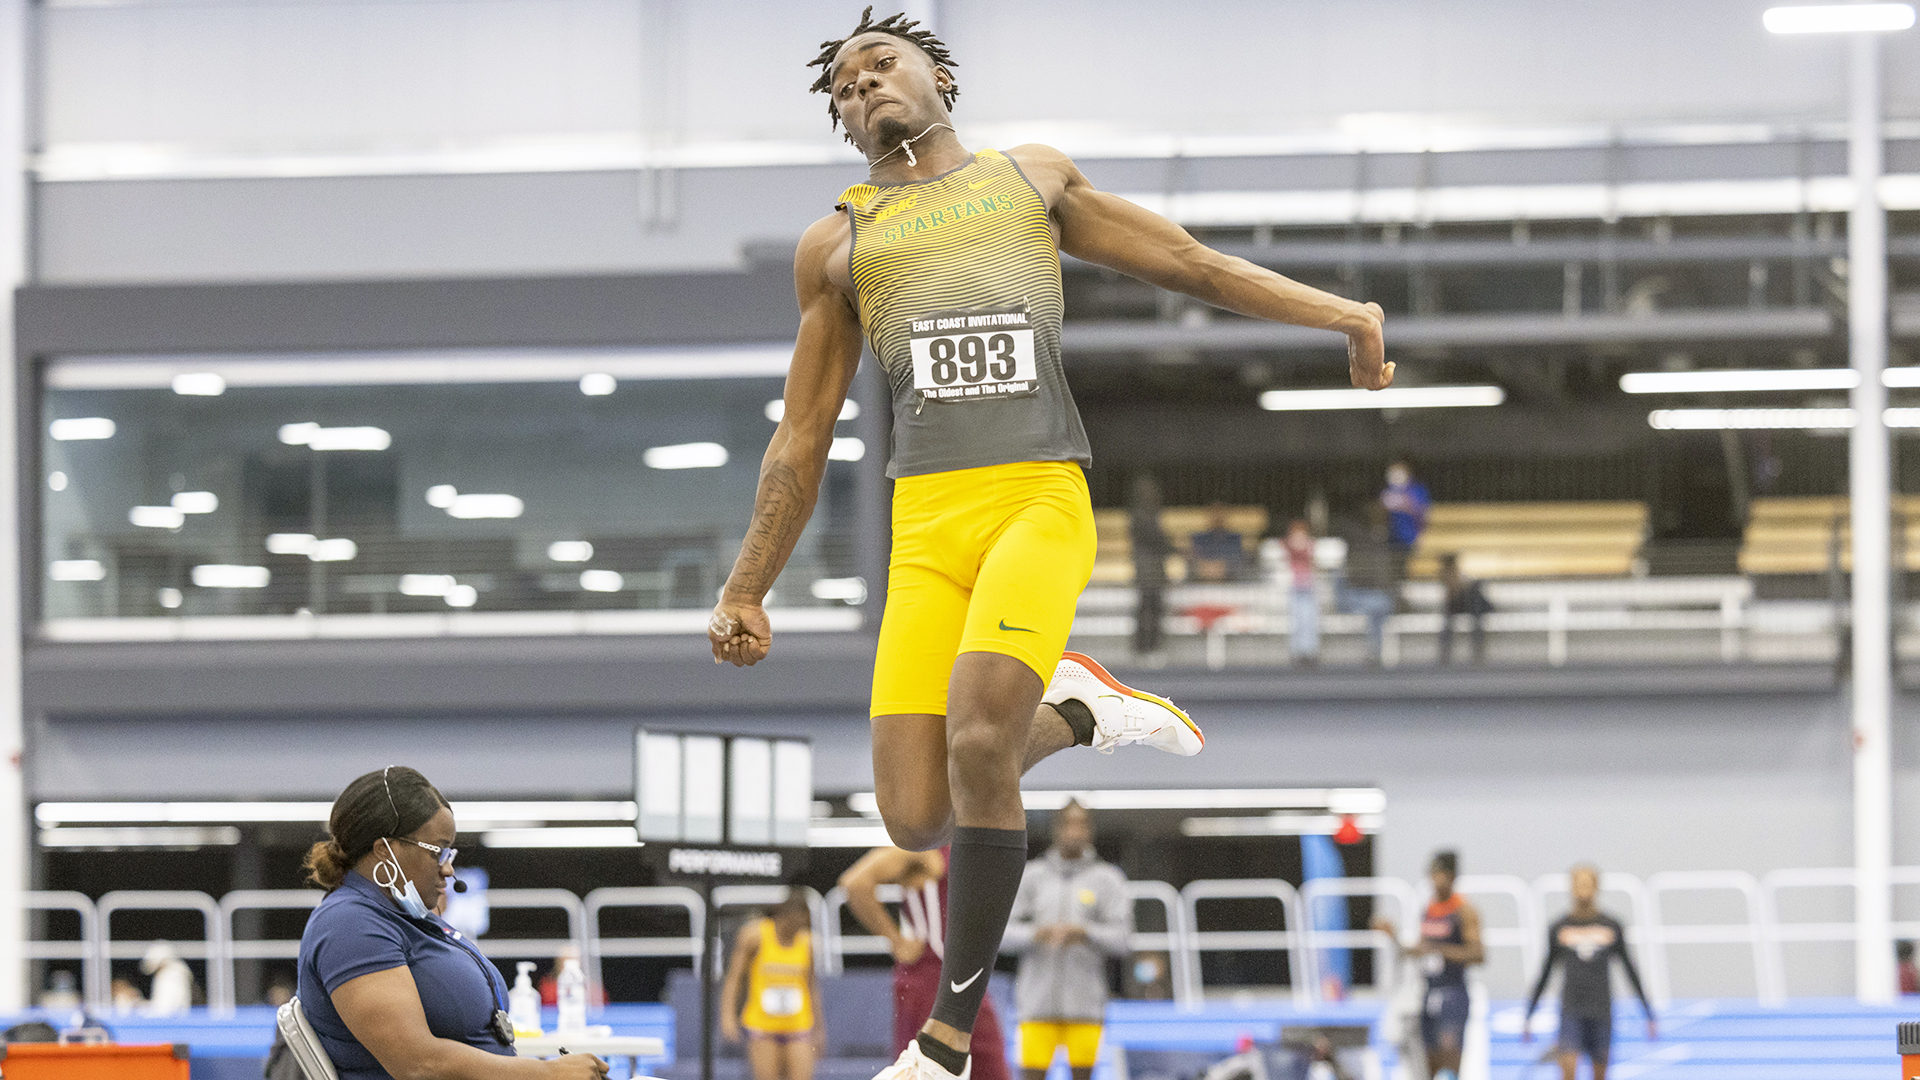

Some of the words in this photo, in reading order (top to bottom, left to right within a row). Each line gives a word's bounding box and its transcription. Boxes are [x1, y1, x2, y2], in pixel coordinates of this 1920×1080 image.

[884, 193, 1014, 244] SPARTANS
[912, 320, 935, 333] EAST
[936, 317, 966, 330] COAST
[967, 313, 1028, 328] INVITATIONAL
[929, 333, 1016, 386] 893
[922, 389, 938, 399] The
[938, 386, 963, 398] Oldest
[965, 385, 980, 396] and
[981, 384, 997, 395] The
[998, 381, 1029, 394] Original
